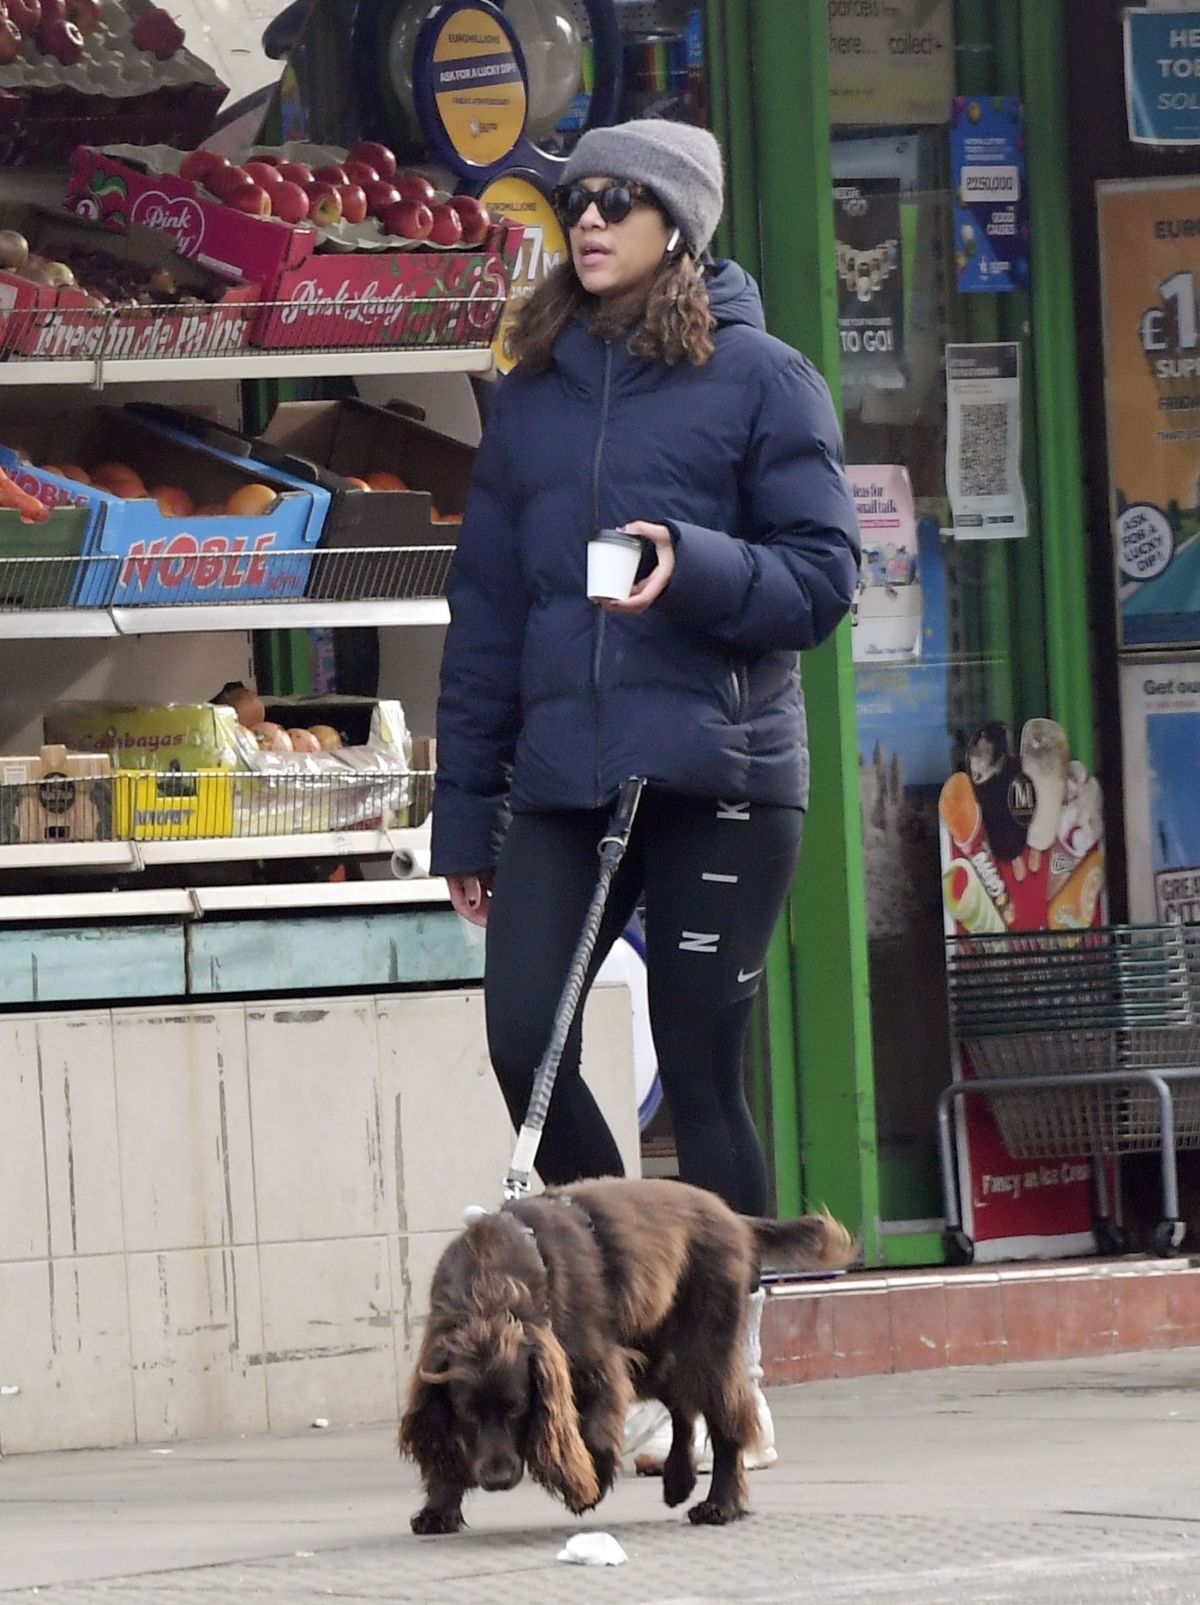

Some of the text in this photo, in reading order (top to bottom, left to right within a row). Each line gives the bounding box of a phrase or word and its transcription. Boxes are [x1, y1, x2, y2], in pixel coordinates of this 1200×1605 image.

[448, 33, 500, 44] EUROMILLIONS
[440, 71, 456, 83] ASK
[456, 68, 471, 80] FOR
[471, 67, 478, 78] A
[478, 65, 500, 77] LUCKY
[281, 279, 349, 324] Pink
[840, 330, 894, 351] TO GO!
[1123, 512, 1148, 531] ASK
[1122, 529, 1146, 547] FOR
[119, 532, 277, 592] NOBLE
[1144, 679, 1174, 695] Get
[982, 1174, 1022, 1199] Fancy
